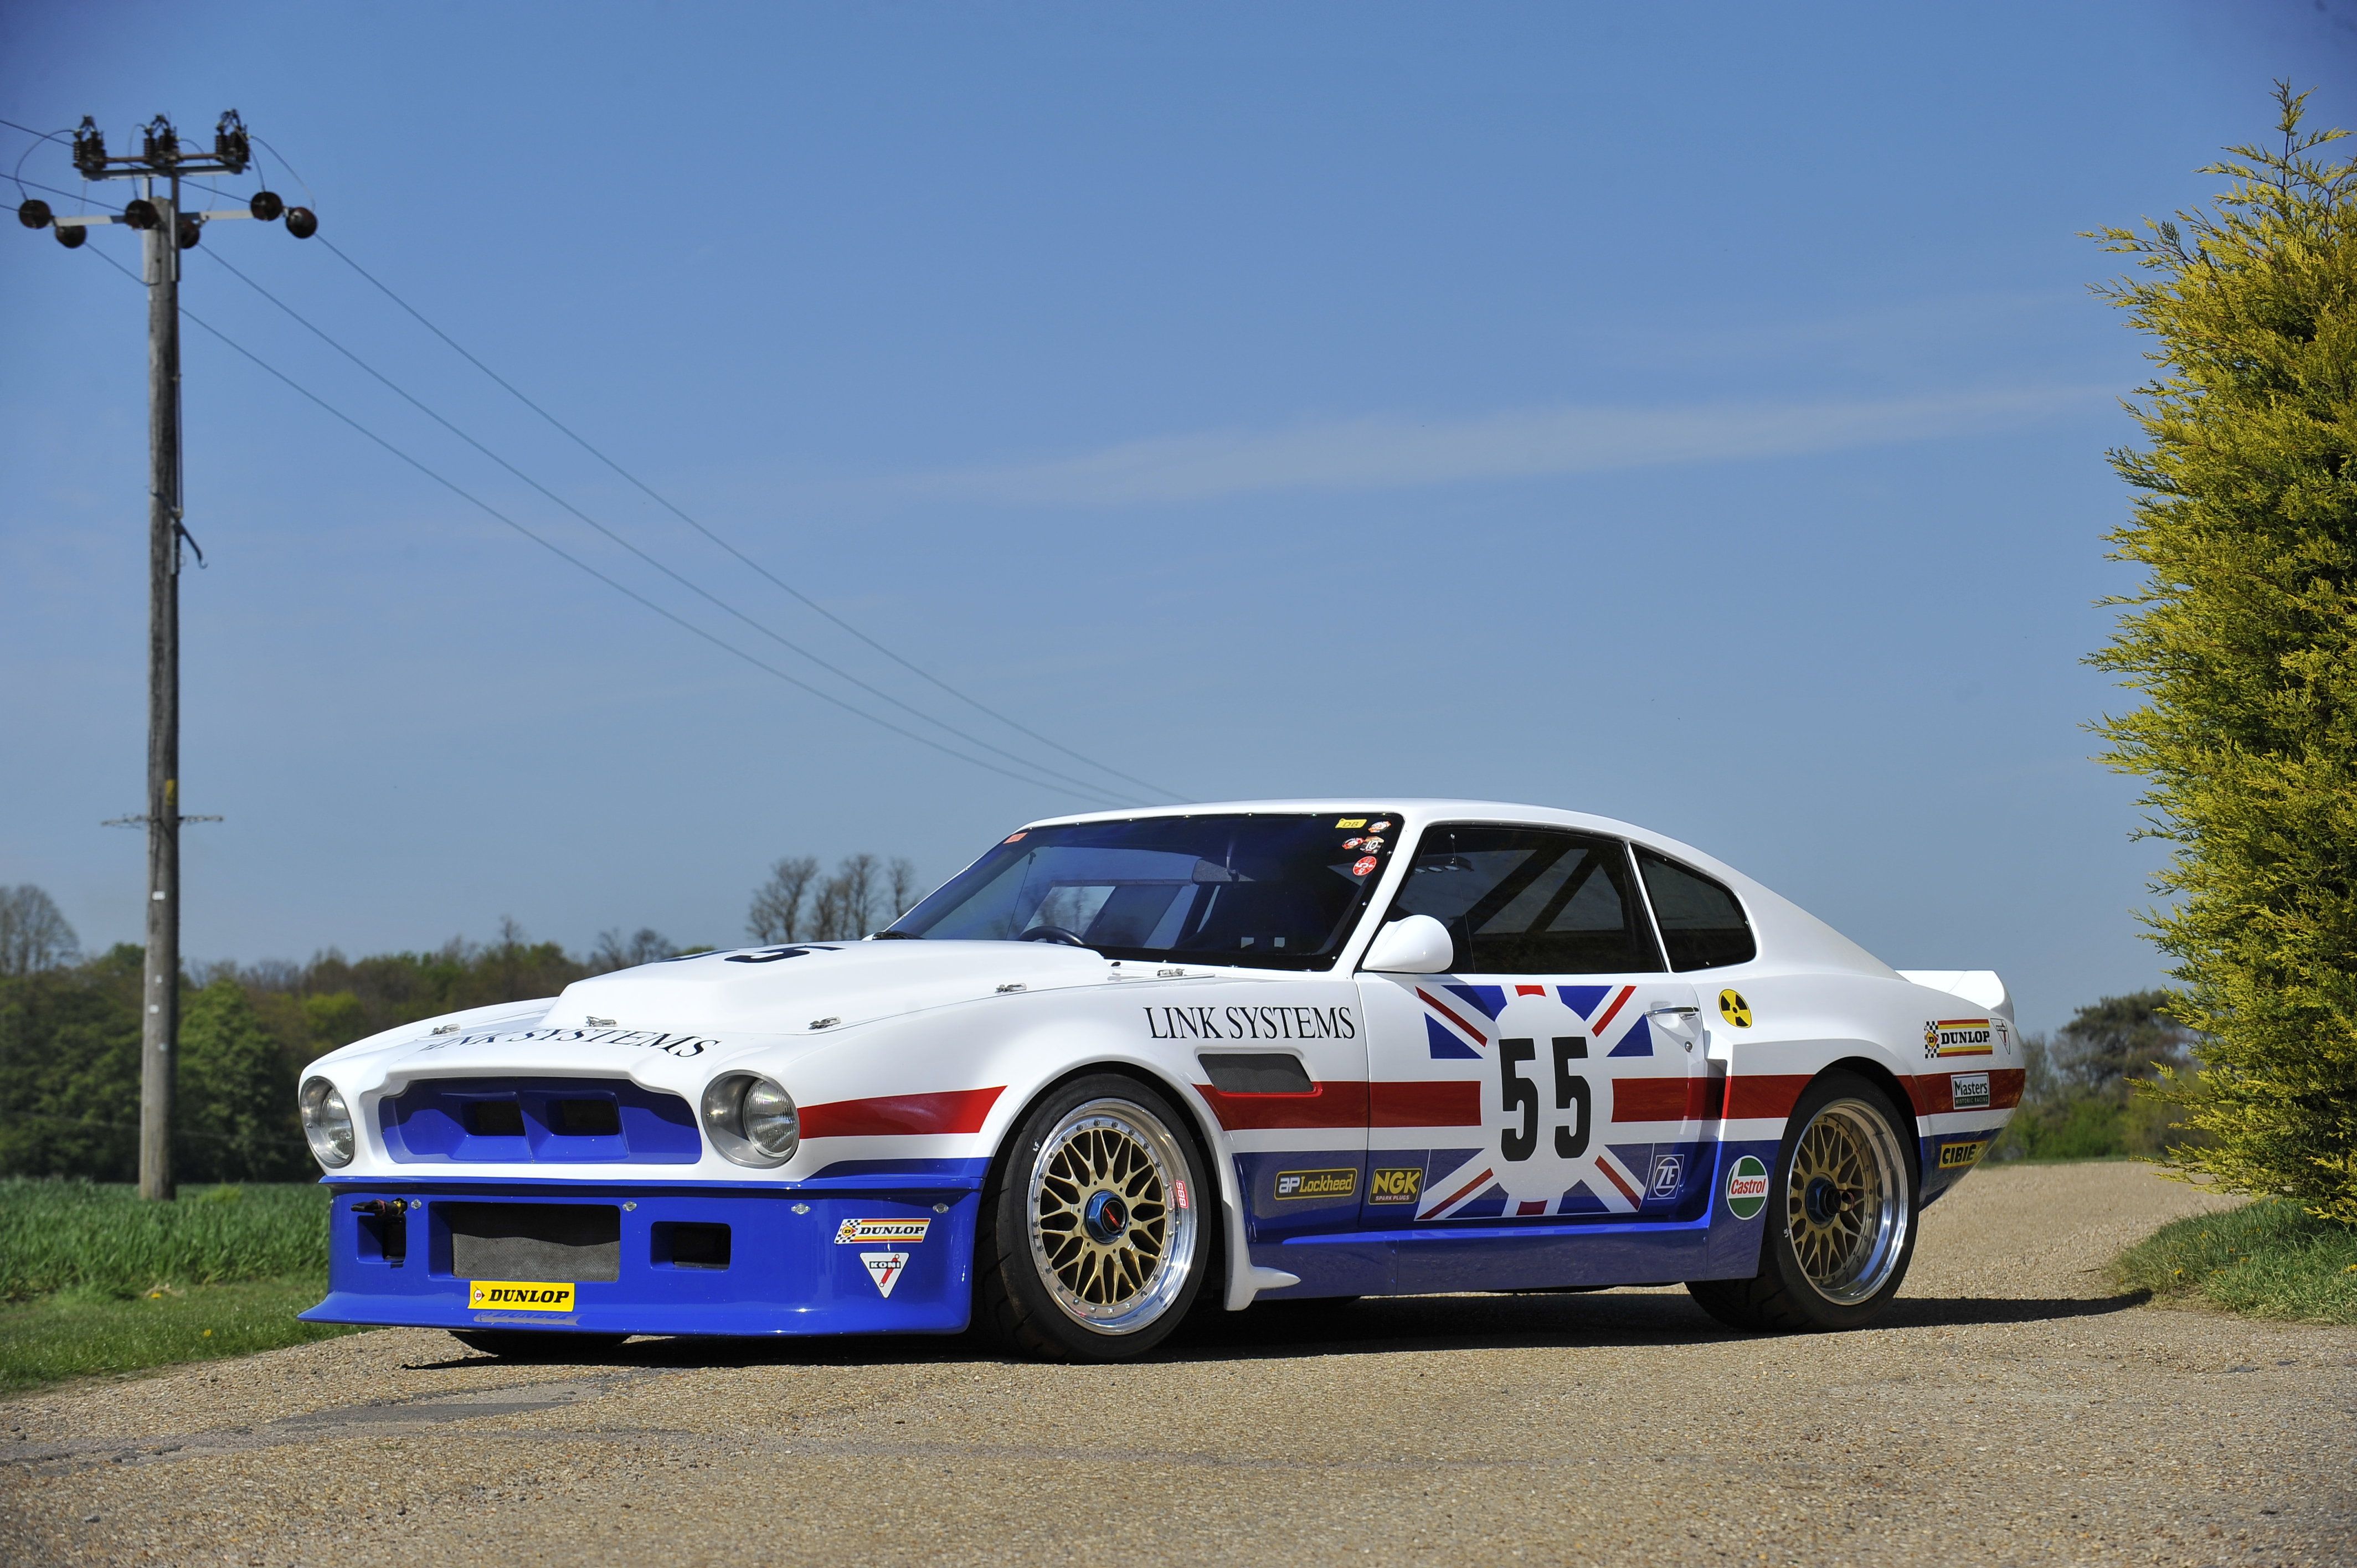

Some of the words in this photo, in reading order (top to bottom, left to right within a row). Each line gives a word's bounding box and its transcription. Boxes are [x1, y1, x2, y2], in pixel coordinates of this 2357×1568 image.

[1143, 1007, 1224, 1039] LINK
[1226, 1007, 1355, 1039] SYSTEMS
[506, 1028, 722, 1058] SYSTEMS
[1940, 1030, 1990, 1045] DUNLOP
[1498, 1036, 1592, 1162] 55
[1954, 1080, 1988, 1096] Masters
[1299, 1173, 1354, 1193] Lockheed
[1372, 1171, 1421, 1195] NGK
[1655, 1165, 1680, 1189] ZF
[1731, 1178, 1767, 1195] Castrol
[1176, 1181, 1187, 1207] BBS
[858, 1226, 925, 1235] DUNLOP
[488, 1289, 570, 1303] DUNLOP
